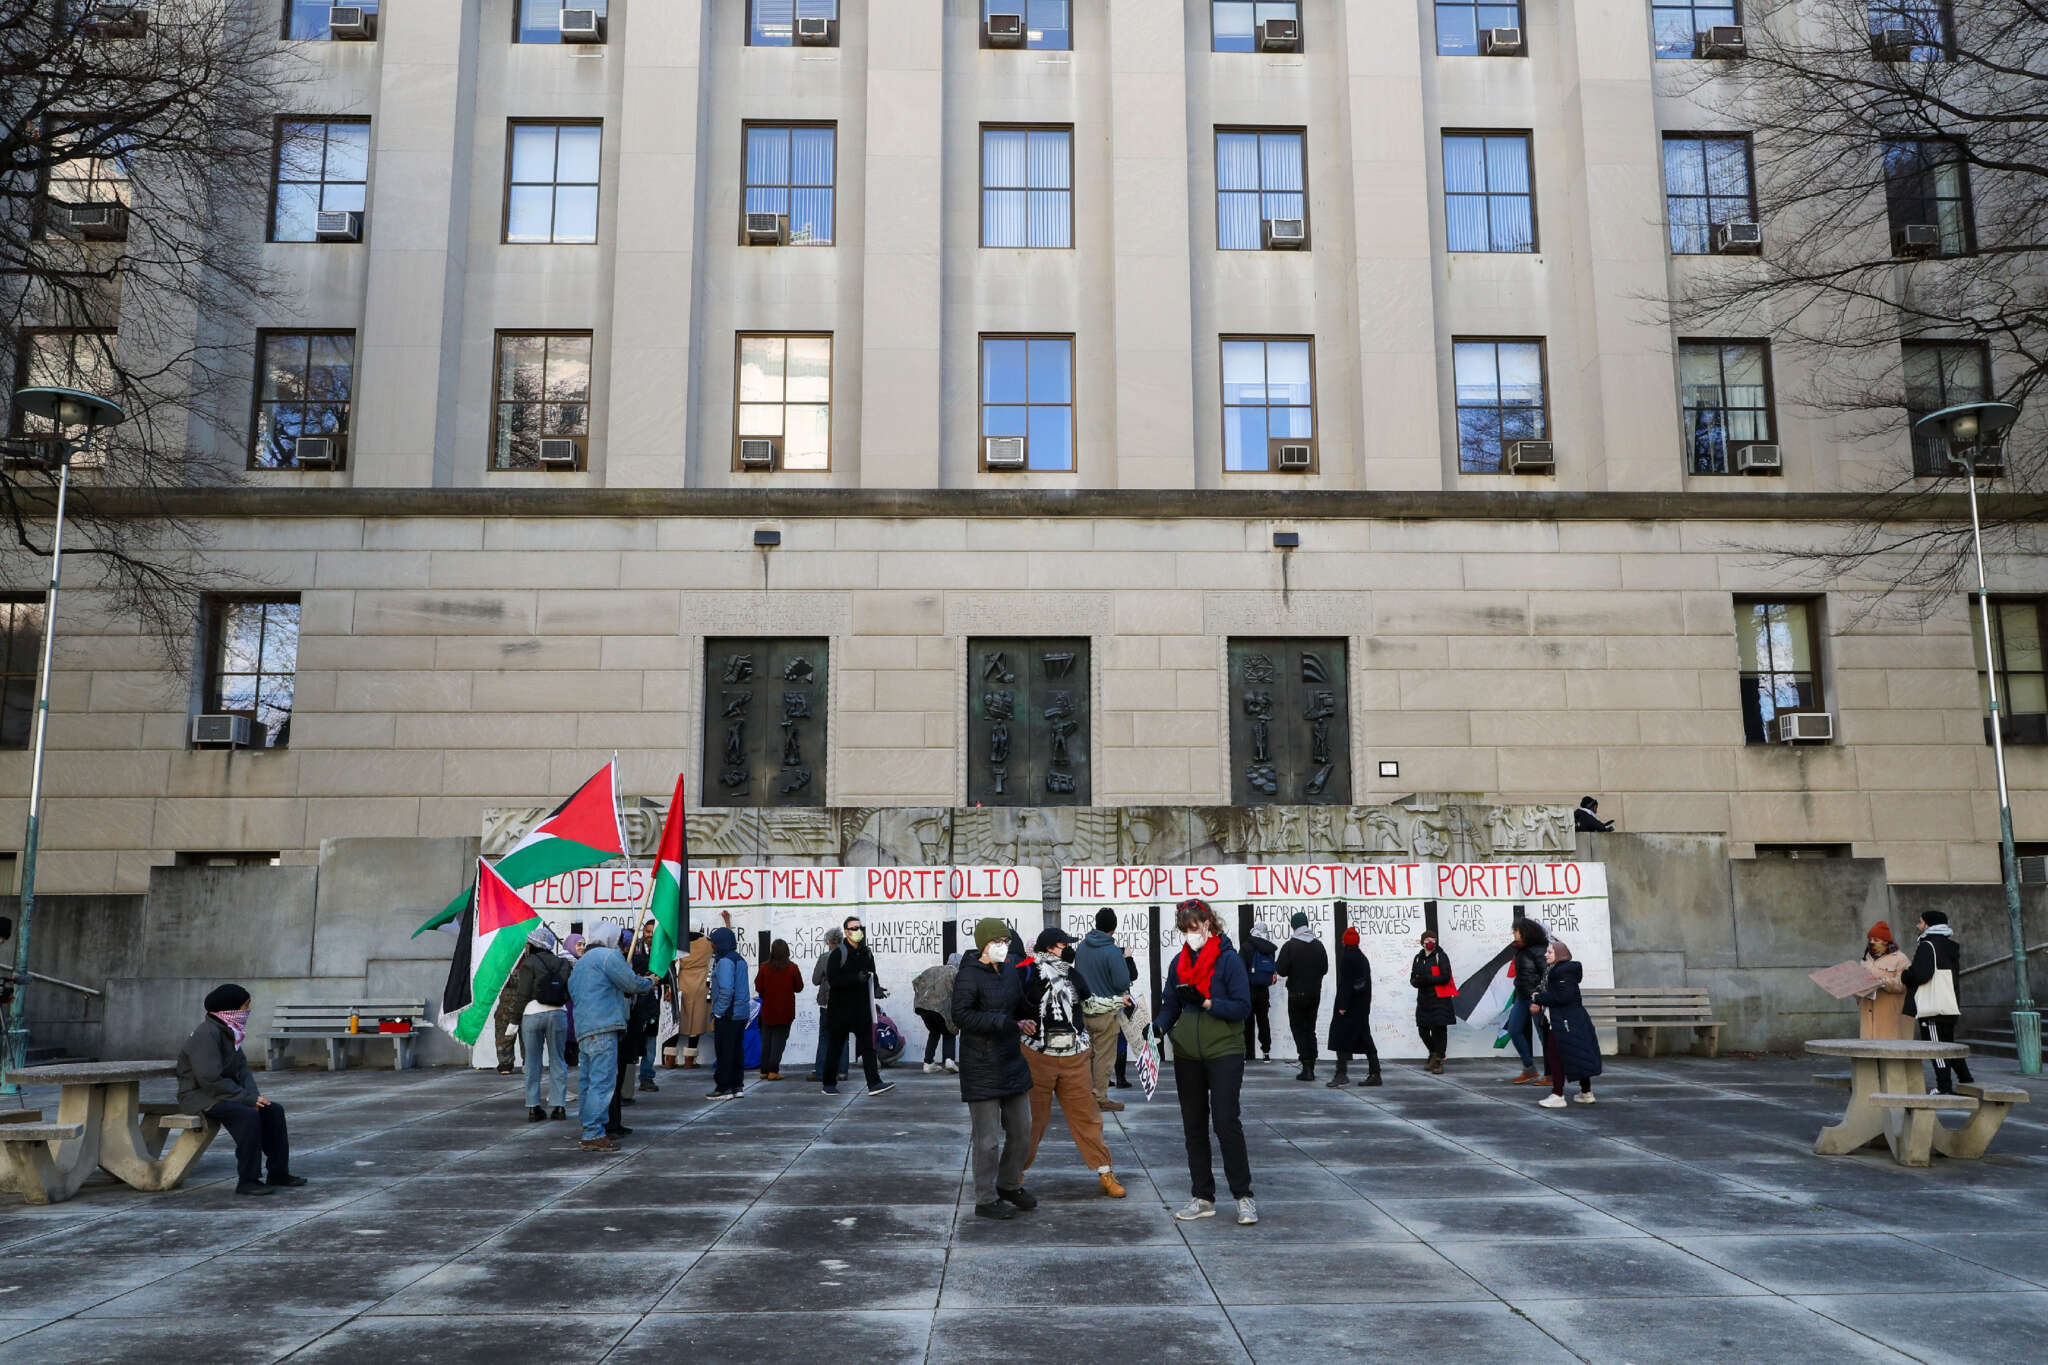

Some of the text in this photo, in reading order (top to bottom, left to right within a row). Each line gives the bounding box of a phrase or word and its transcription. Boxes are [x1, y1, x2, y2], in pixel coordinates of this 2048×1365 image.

[532, 869, 645, 904] PEOPLES
[868, 868, 1020, 899] PORTFOLIO
[1062, 863, 1581, 898] THE PEOPLES INVSTMENT PORTFOLIO
[1347, 904, 1422, 921] REPRODUCTIVE
[1453, 904, 1484, 919] FAIR
[1542, 903, 1576, 918] HOME
[871, 920, 942, 937] UNIVERSAL
[1068, 912, 1149, 932] PAR AND
[1352, 919, 1411, 936] SERVICES
[1448, 918, 1486, 932] WAGES
[795, 926, 824, 943] K-12
[867, 936, 941, 954] HEALTHCARE
